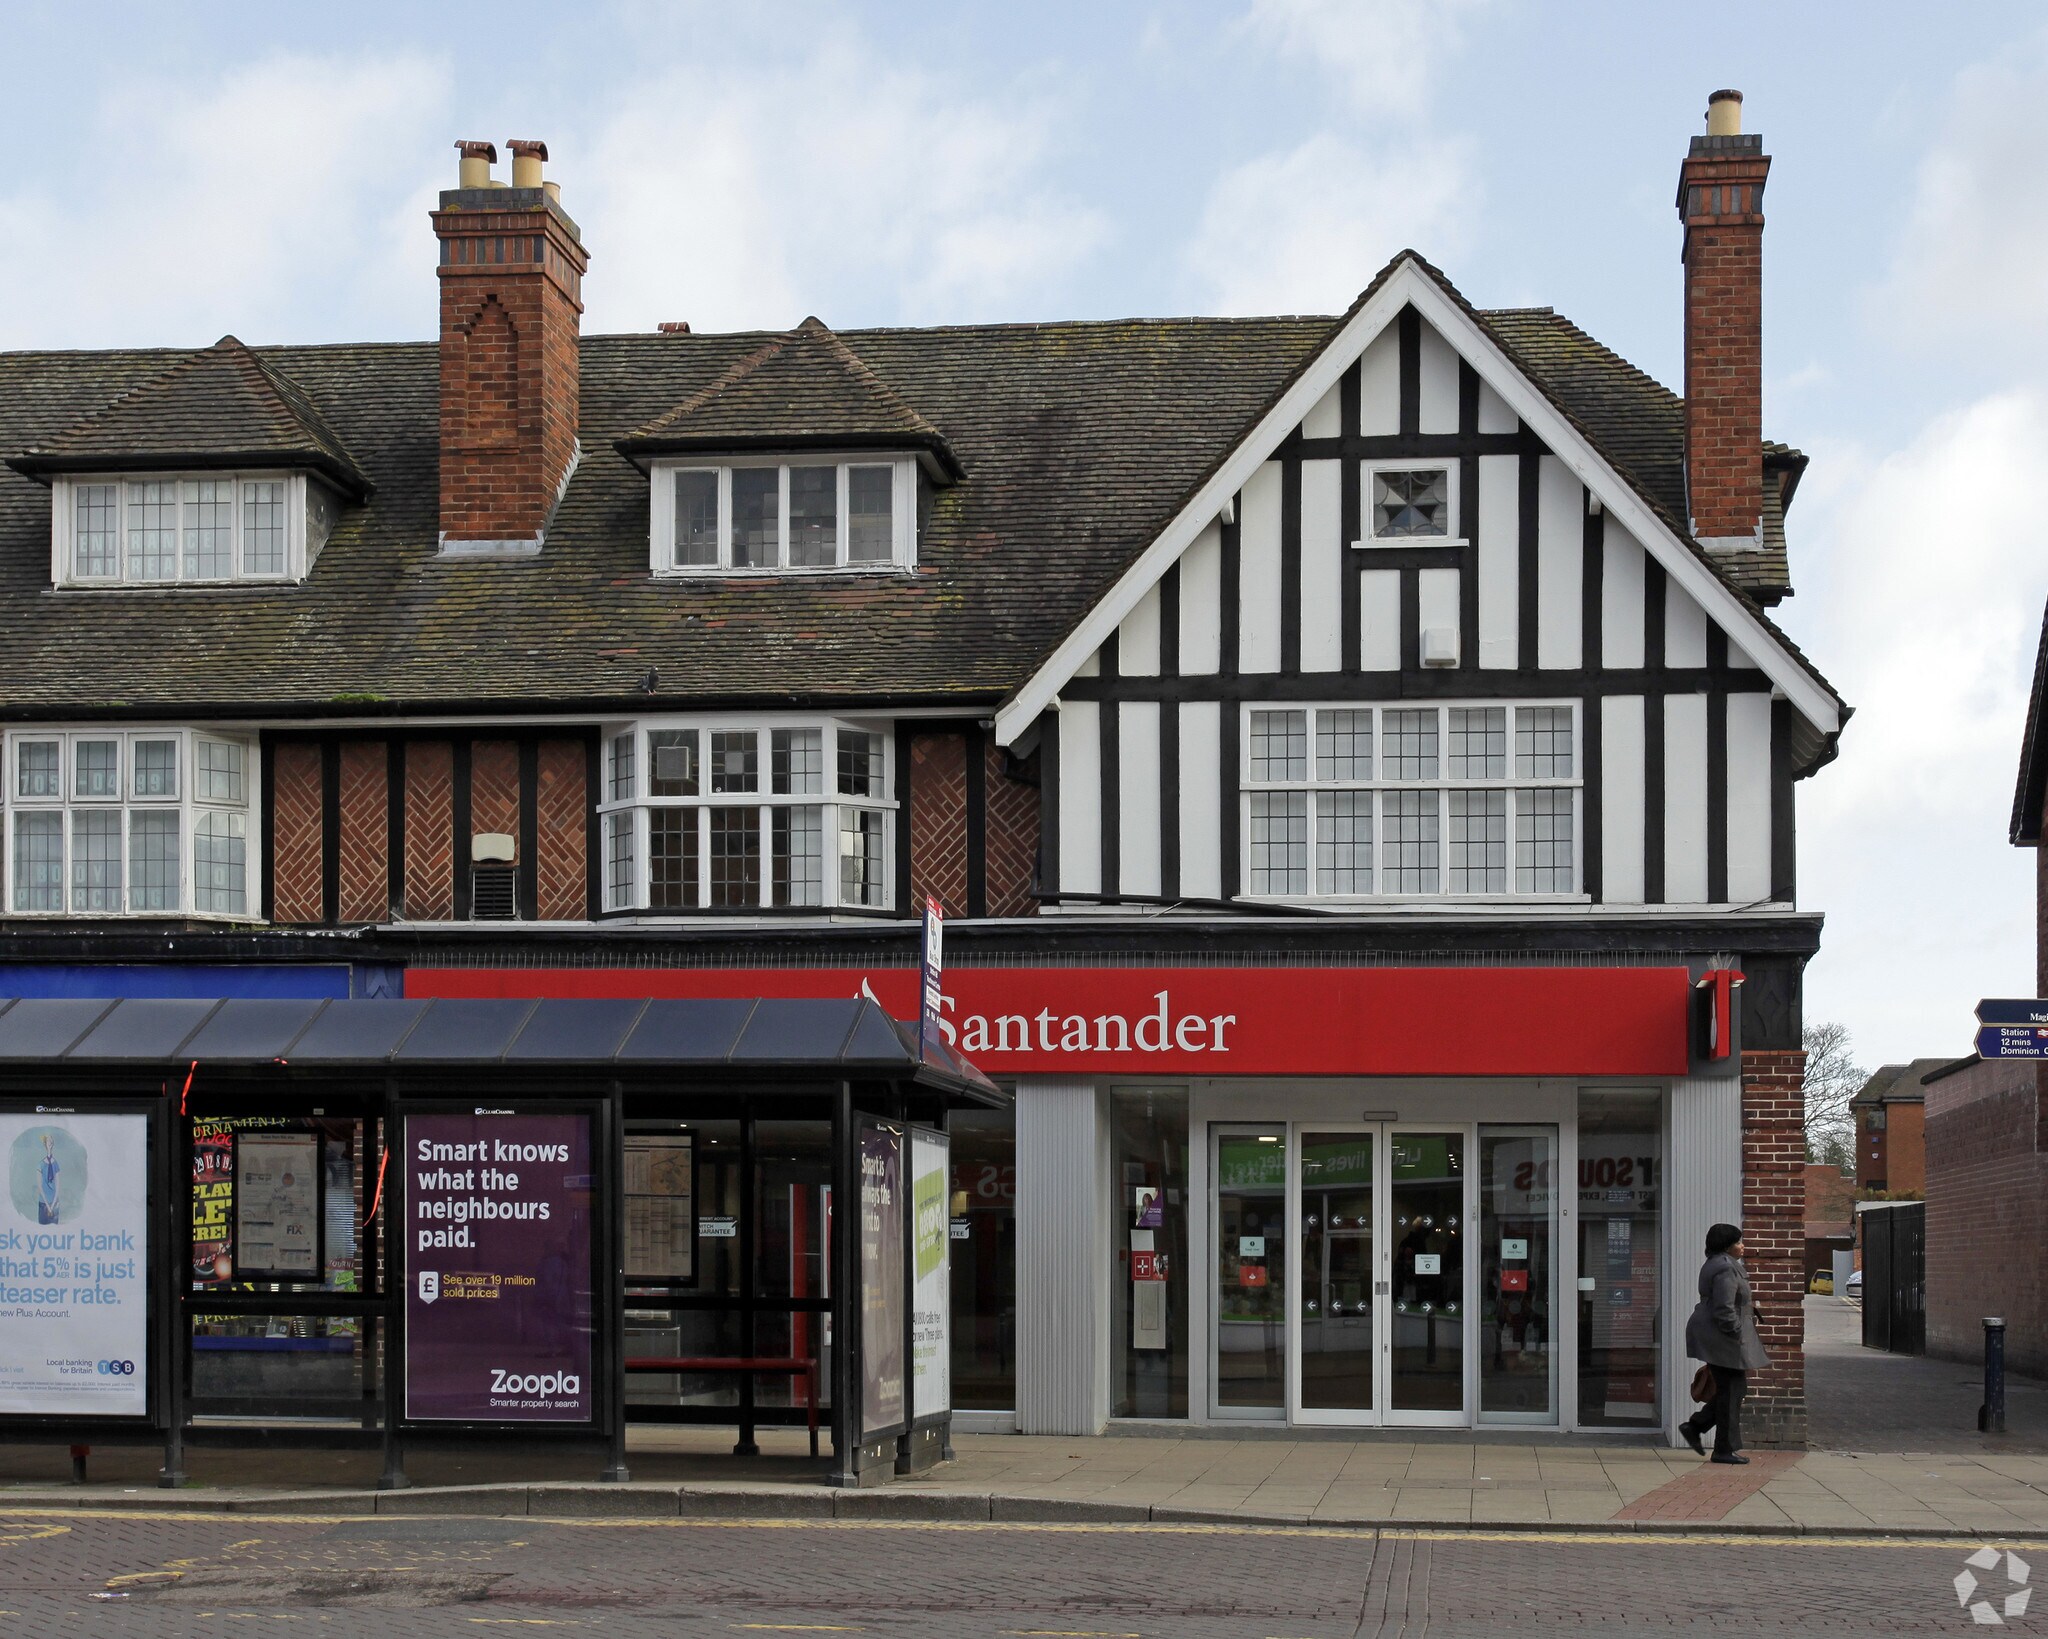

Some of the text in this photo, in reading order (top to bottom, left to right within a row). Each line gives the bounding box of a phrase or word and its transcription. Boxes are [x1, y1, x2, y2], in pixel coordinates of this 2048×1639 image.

[79, 531, 212, 553] ENTRANCE
[91, 557, 197, 577] AT REAR
[36, 864, 103, 884] BODY
[16, 887, 163, 908] PIERCING
[938, 990, 1236, 1053] Santander
[2001, 1028, 2029, 1036] Station
[2001, 1038, 2031, 1046] 12 mins
[2001, 1047, 2039, 1055] Dominion
[418, 1139, 569, 1162] Smart knows
[206, 1154, 214, 1169] 12
[862, 1152, 885, 1177] Smart is
[418, 1168, 519, 1191] what the
[880, 1184, 891, 1205] the
[418, 1196, 551, 1223] neighbours
[26, 1233, 75, 1255] your
[80, 1229, 135, 1251] bank
[418, 1226, 476, 1251] paid.
[74, 1257, 91, 1279] is
[95, 1257, 136, 1283] just
[443, 1274, 536, 1286] See over 19 million
[0, 1282, 122, 1305] teaser rate.
[423, 1277, 434, 1293] £
[443, 1287, 499, 1299] sold prices
[16, 1308, 33, 1318] Plus
[35, 1309, 71, 1318] Account.
[66, 1360, 93, 1368] banking
[99, 1361, 134, 1374] TSB
[490, 1369, 580, 1399] Zoopla
[490, 1398, 579, 1409] Smarter property search
